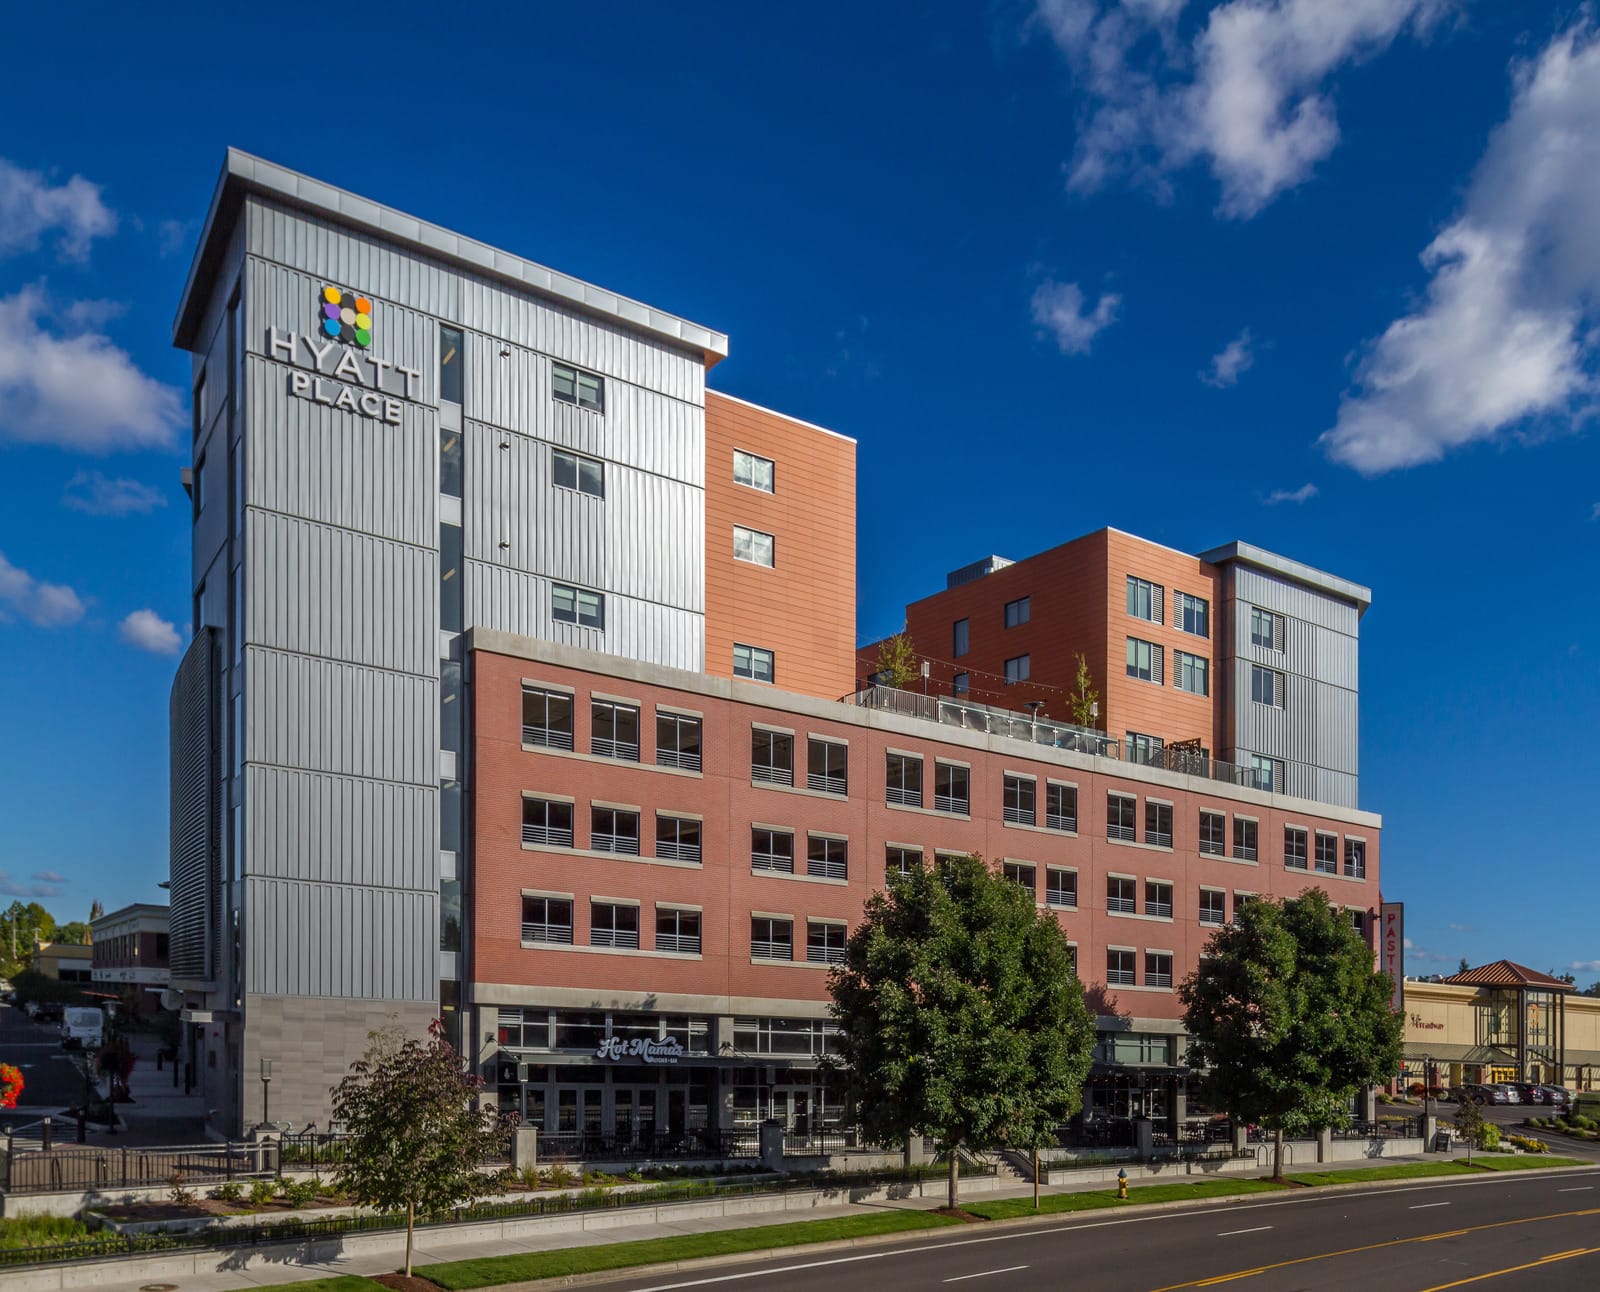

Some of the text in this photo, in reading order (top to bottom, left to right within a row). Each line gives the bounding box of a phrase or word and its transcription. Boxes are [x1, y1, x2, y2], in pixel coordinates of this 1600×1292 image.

[269, 325, 422, 399] HYATT
[290, 370, 402, 424] PLACE
[596, 1035, 684, 1063] Hot Mama's
